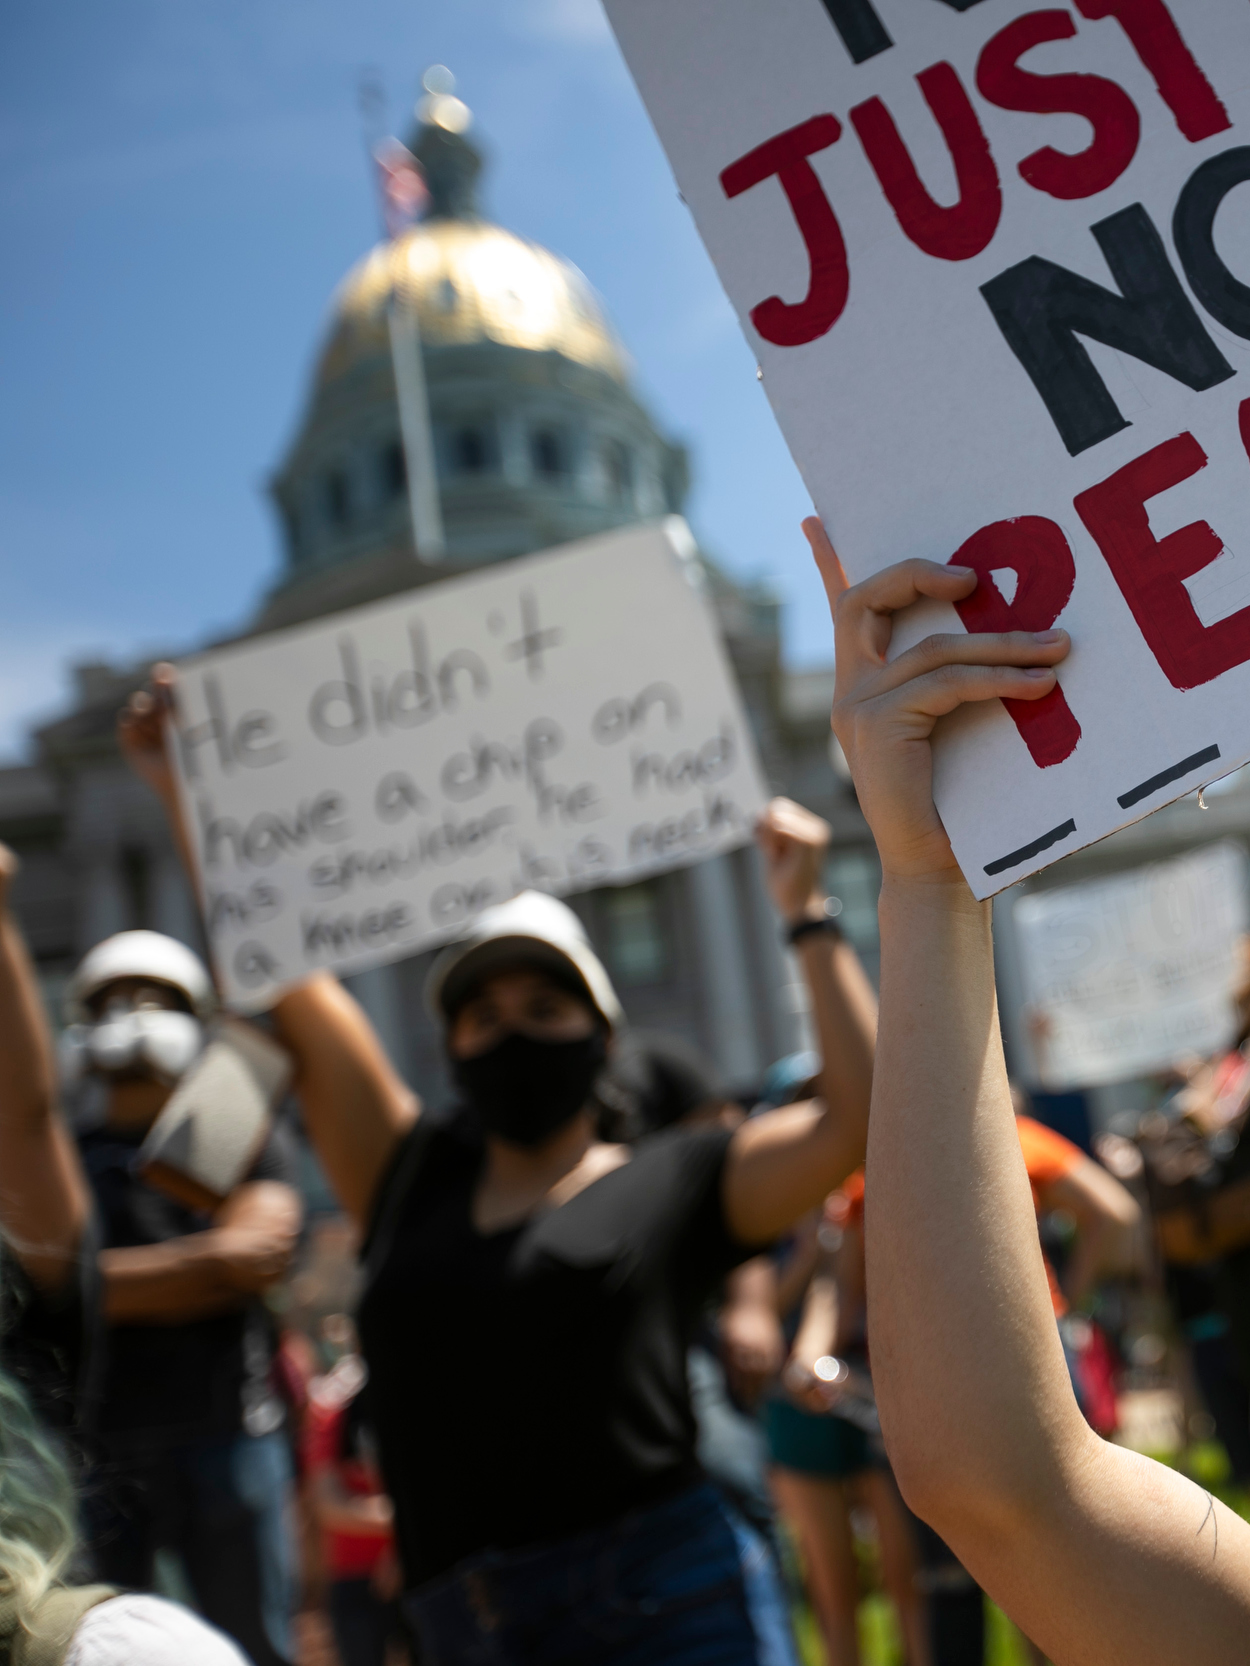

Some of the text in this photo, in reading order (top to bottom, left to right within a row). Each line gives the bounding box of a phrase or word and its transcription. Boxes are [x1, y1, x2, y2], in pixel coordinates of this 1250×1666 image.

[178, 583, 566, 784] He didn't
[200, 680, 684, 870] have a chip on
[534, 780, 604, 827] he
[630, 714, 738, 797] had
[233, 938, 282, 989] a
[429, 878, 500, 928] on
